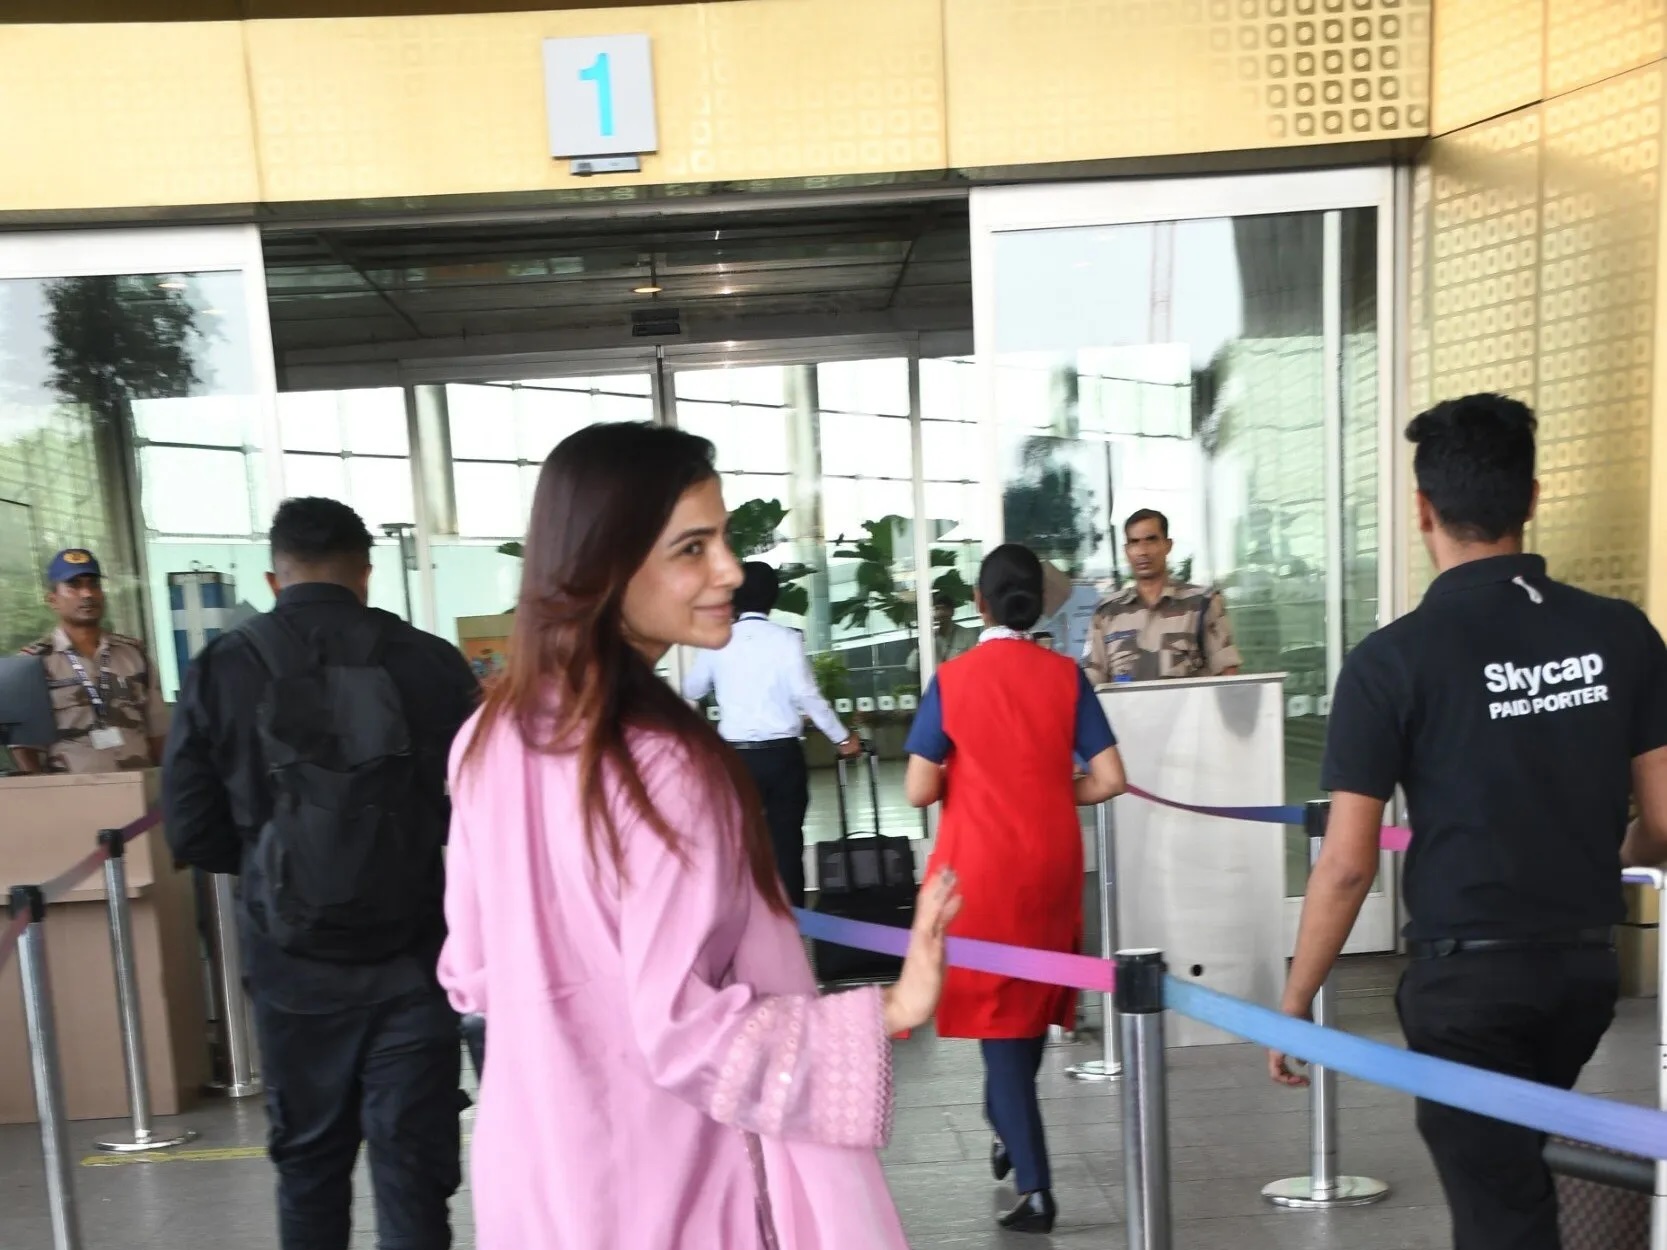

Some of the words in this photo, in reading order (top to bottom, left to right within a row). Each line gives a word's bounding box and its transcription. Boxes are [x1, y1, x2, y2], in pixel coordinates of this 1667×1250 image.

[578, 52, 614, 136] 1
[1484, 653, 1604, 696] Skycap
[1488, 699, 1531, 719] PAID
[1532, 685, 1609, 714] PORTER
